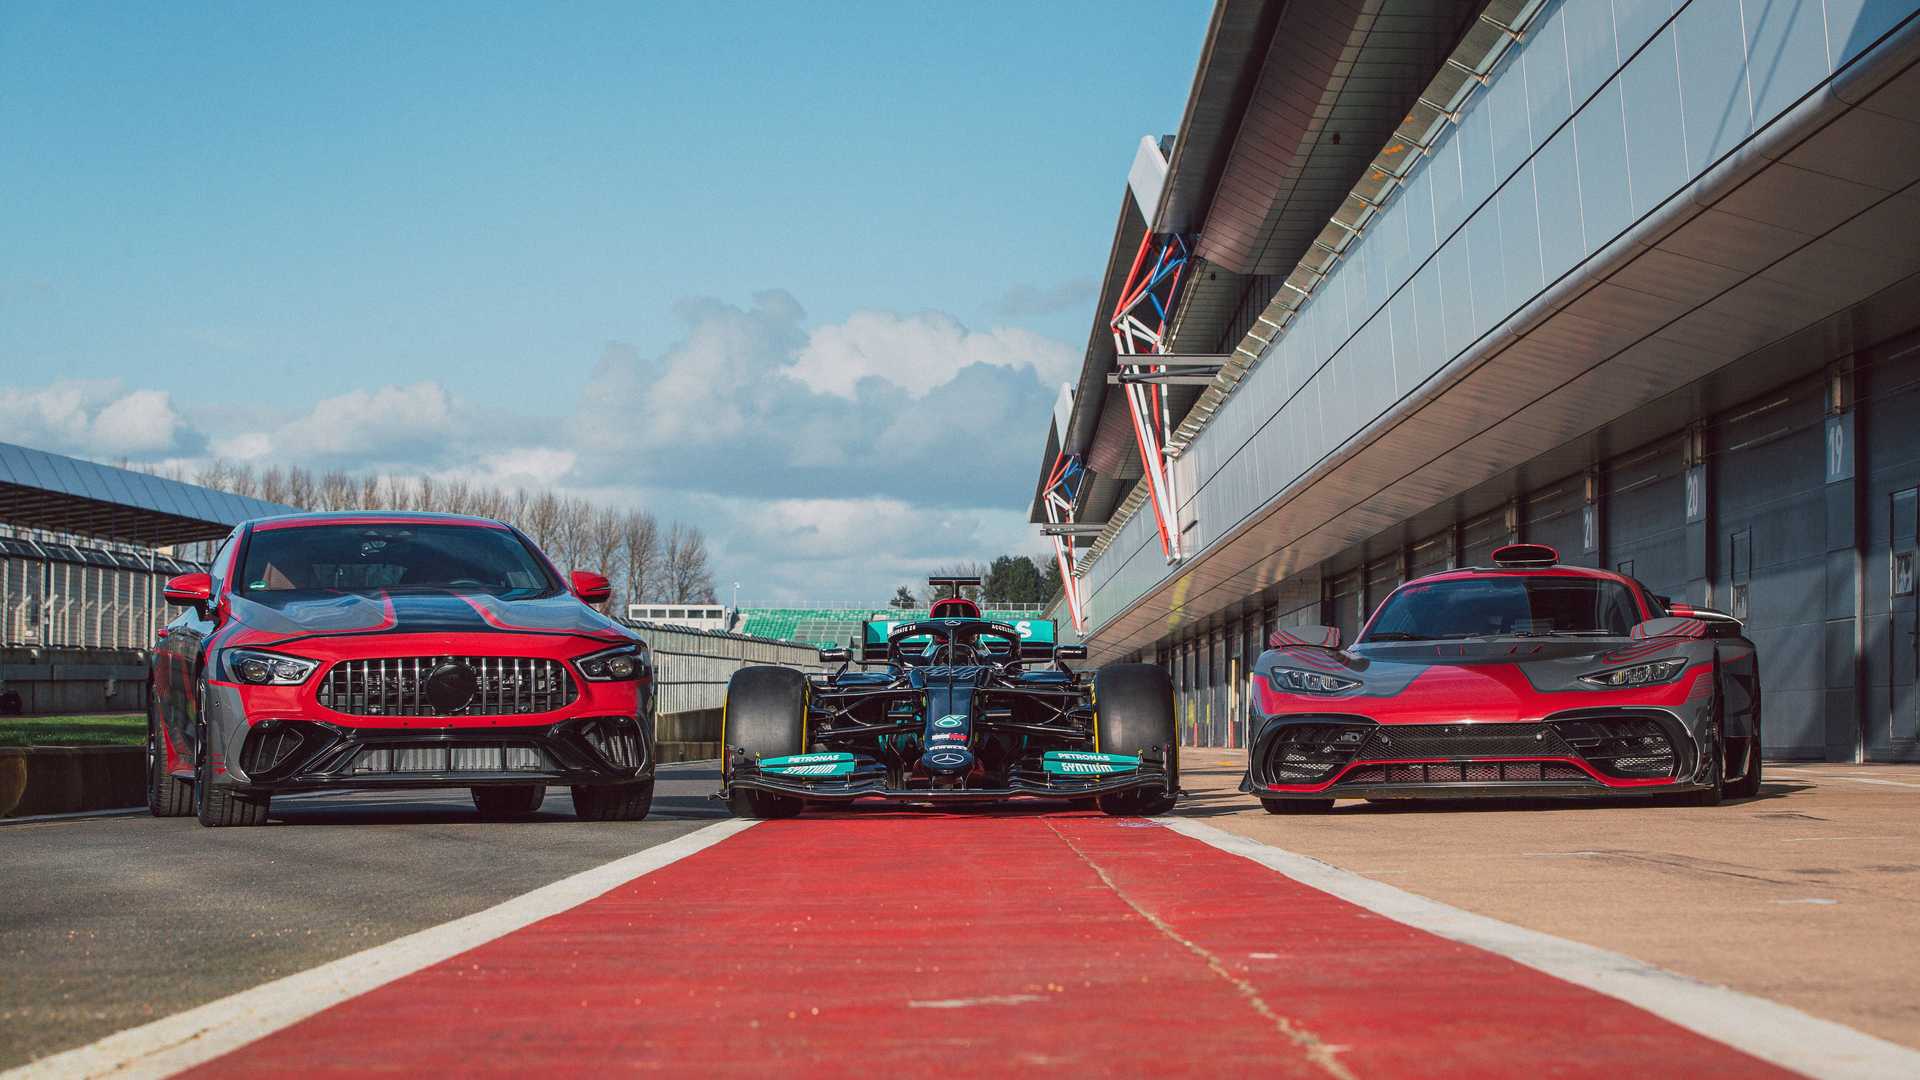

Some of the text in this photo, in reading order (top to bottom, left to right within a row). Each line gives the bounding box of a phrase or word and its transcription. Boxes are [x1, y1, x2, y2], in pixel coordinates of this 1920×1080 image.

[1828, 425, 1843, 475] 19
[1687, 474, 1698, 517] 20
[1584, 511, 1593, 549] 21
[788, 754, 840, 763] PETRONAS
[1057, 753, 1110, 761] PETRONAS
